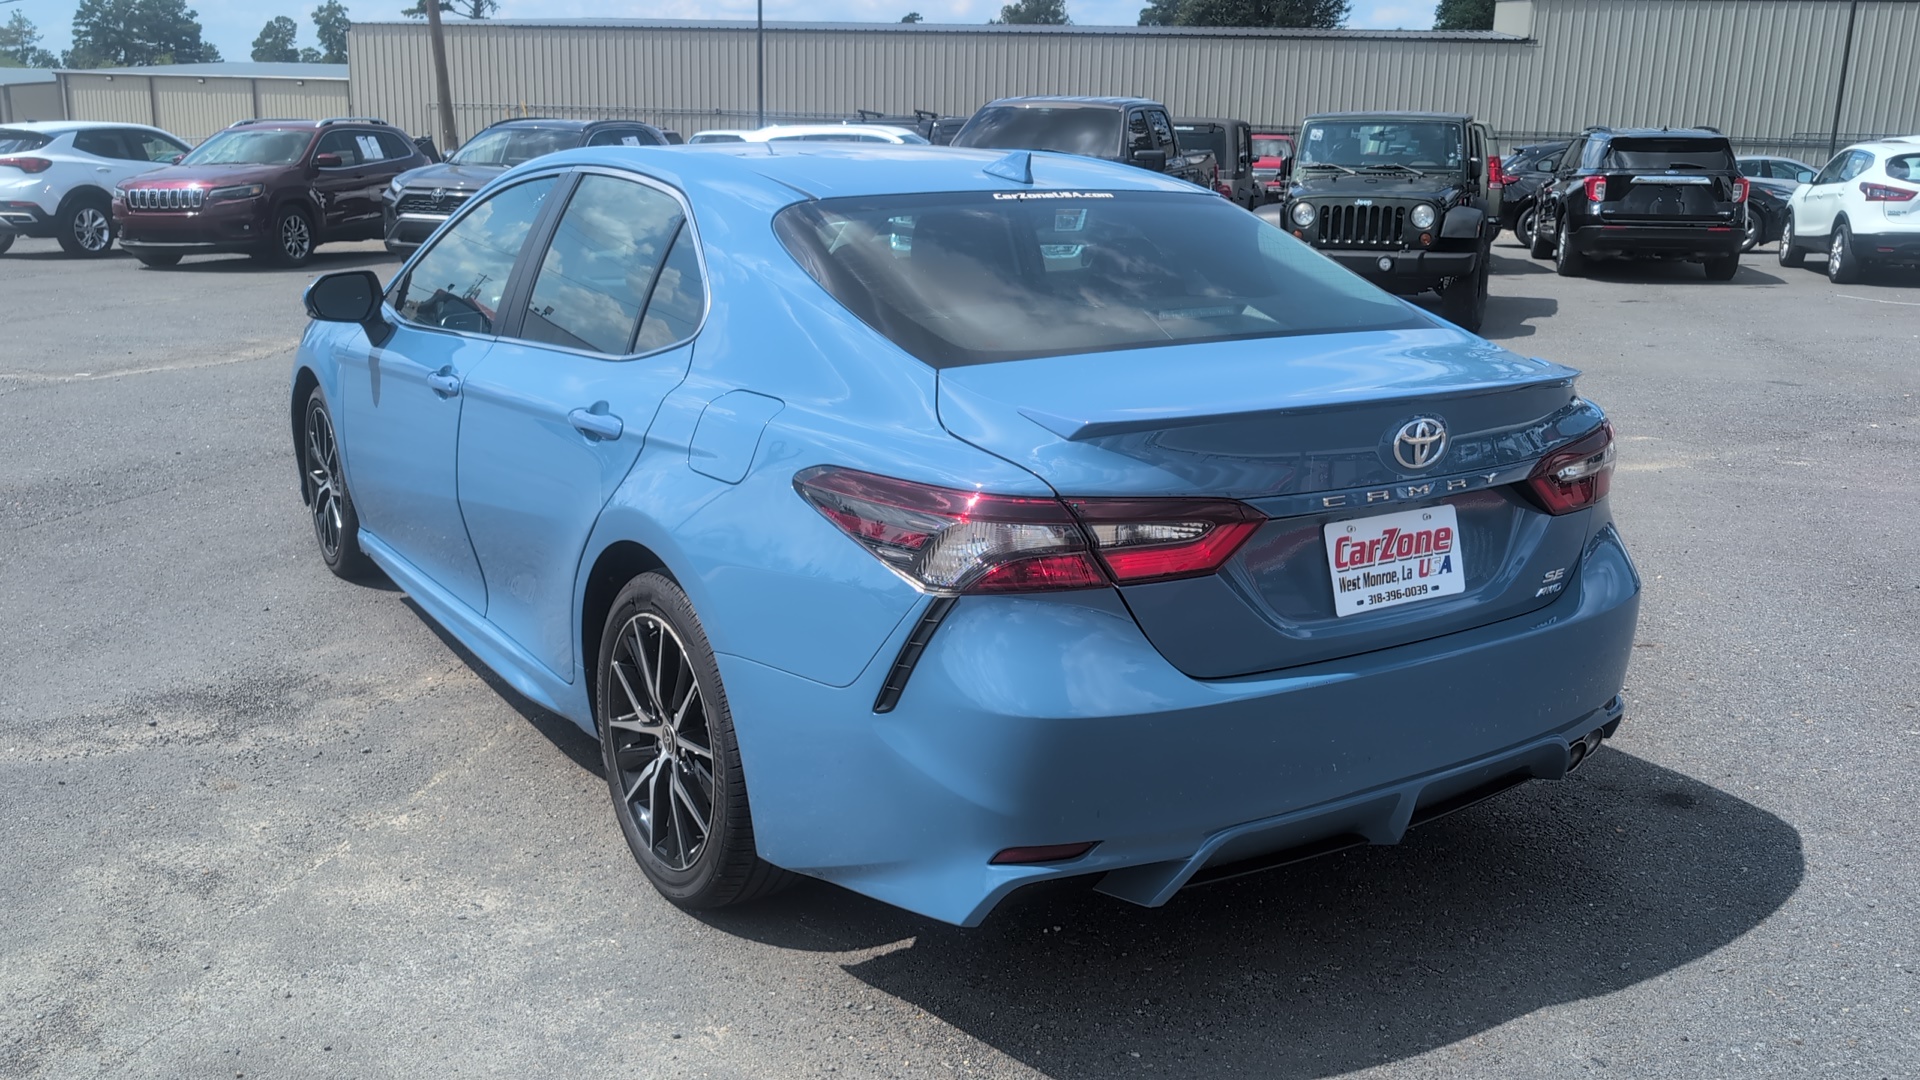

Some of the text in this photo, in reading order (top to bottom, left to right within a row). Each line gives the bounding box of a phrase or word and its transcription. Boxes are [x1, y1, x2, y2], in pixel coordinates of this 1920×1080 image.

[992, 191, 1114, 200] CarZoneUSA.com
[1354, 198, 1373, 207] Jeep
[1322, 472, 1499, 508] CAMRY
[1334, 526, 1454, 573] CarZone
[1418, 555, 1453, 579] USA
[1542, 567, 1566, 584] SE
[1339, 565, 1413, 594] West Monroe, La
